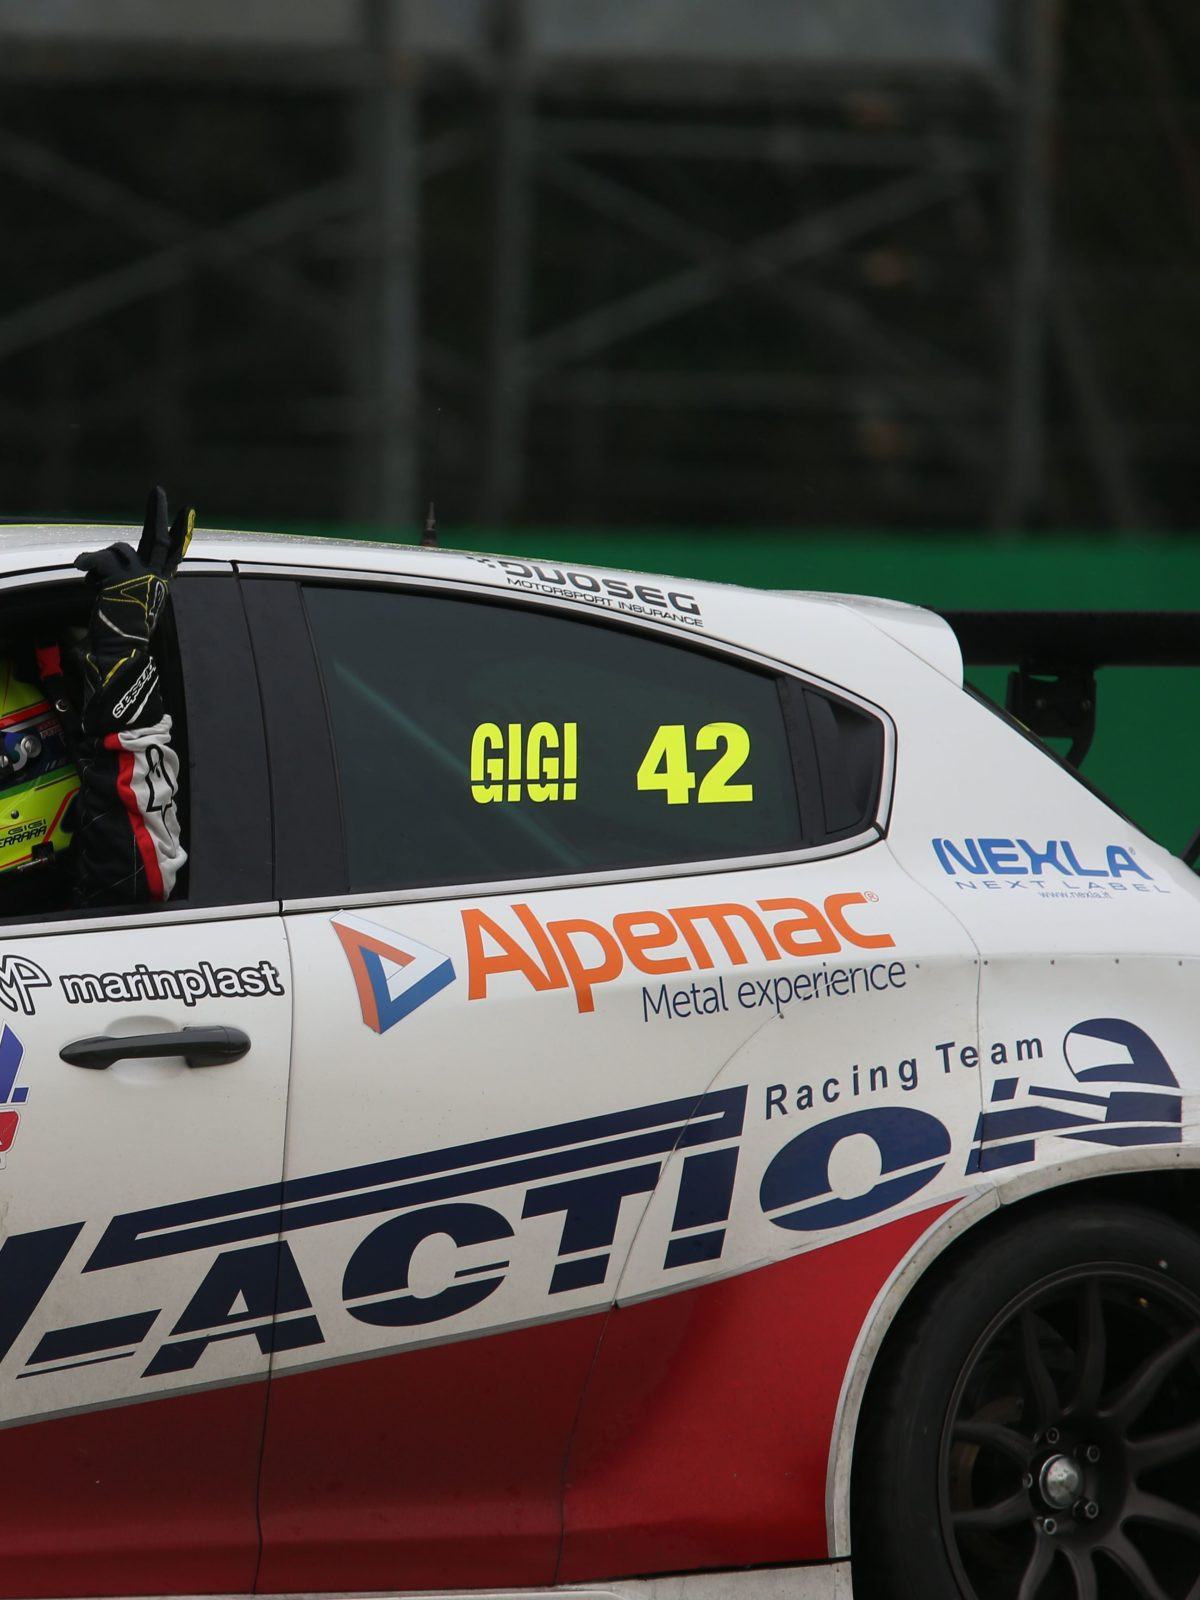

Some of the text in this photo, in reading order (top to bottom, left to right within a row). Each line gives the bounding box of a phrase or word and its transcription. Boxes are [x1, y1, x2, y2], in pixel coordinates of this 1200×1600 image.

[507, 577, 704, 628] MOTORSPORT INSURANCE
[470, 721, 579, 804] GIGI
[636, 721, 754, 806] 42
[8, 819, 47, 834] GIGI
[931, 837, 1154, 881] NEXLA
[955, 880, 1172, 894] NEXT LABEL
[60, 961, 286, 1006] marinplast
[641, 961, 907, 1023] Metal experience
[764, 1037, 1044, 1120] Racing Team
